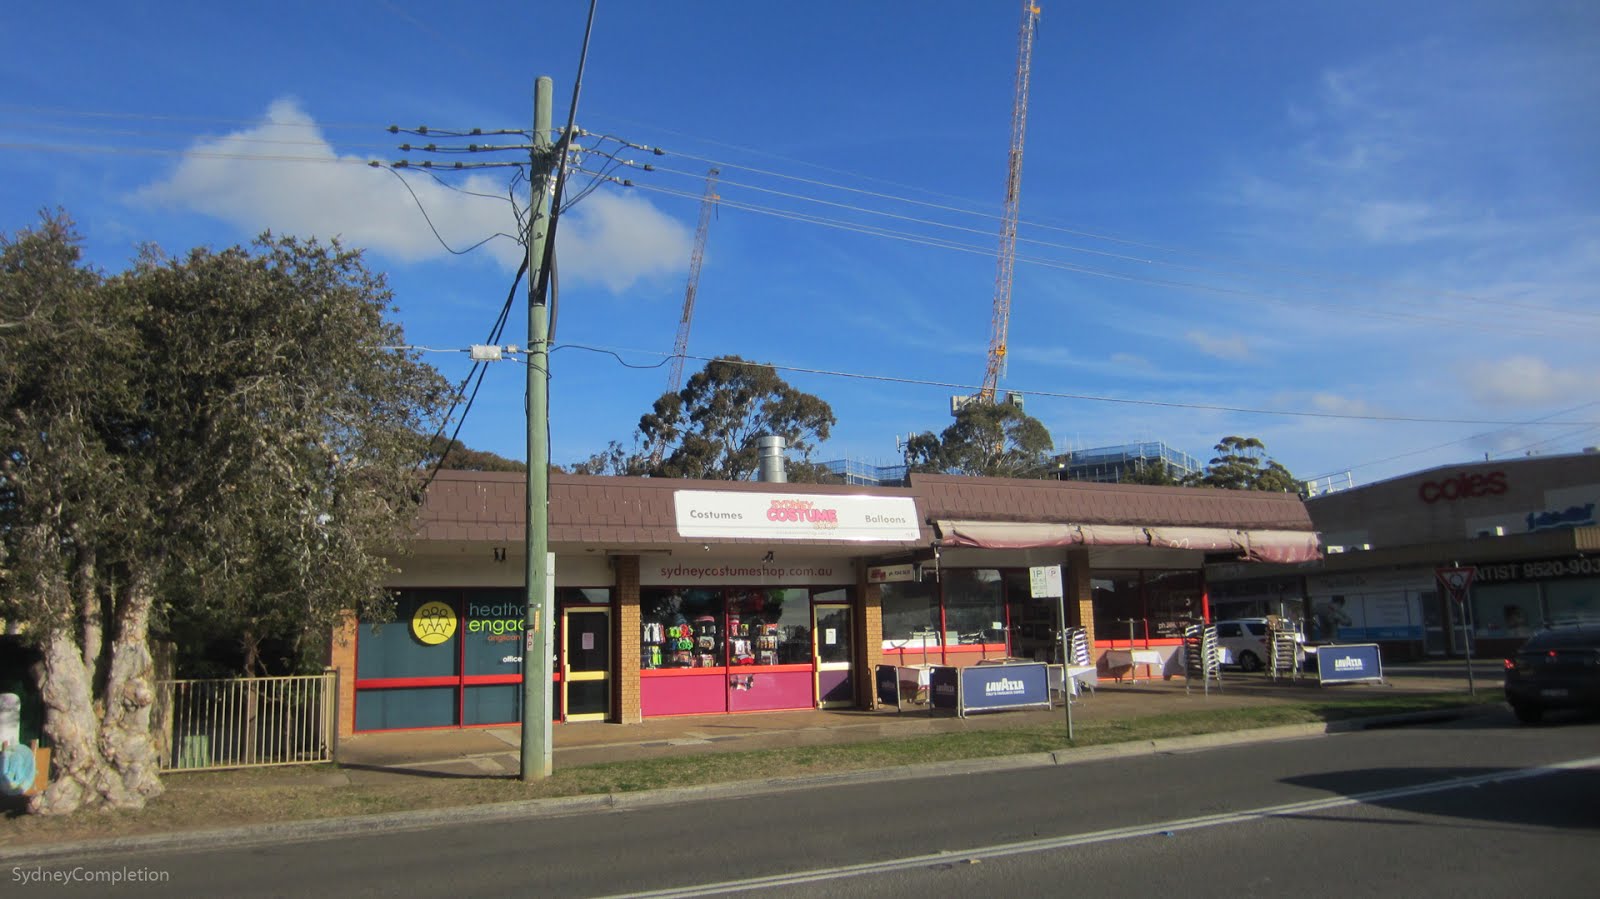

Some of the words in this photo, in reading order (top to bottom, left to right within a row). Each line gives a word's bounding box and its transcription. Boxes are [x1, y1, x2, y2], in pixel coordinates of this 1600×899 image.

[1418, 470, 1508, 503] coles
[770, 499, 814, 510] SYDNEY
[690, 509, 743, 520] Costumes
[766, 507, 838, 523] COSTUME
[865, 514, 906, 525] Balloons
[661, 564, 833, 579] sydneycostumeshop.com.au
[1472, 563, 1520, 581] NTIST
[469, 602, 525, 617] heathc
[487, 634, 521, 643] anglican
[502, 655, 523, 663] office
[985, 677, 1025, 692] LAVAZZA
